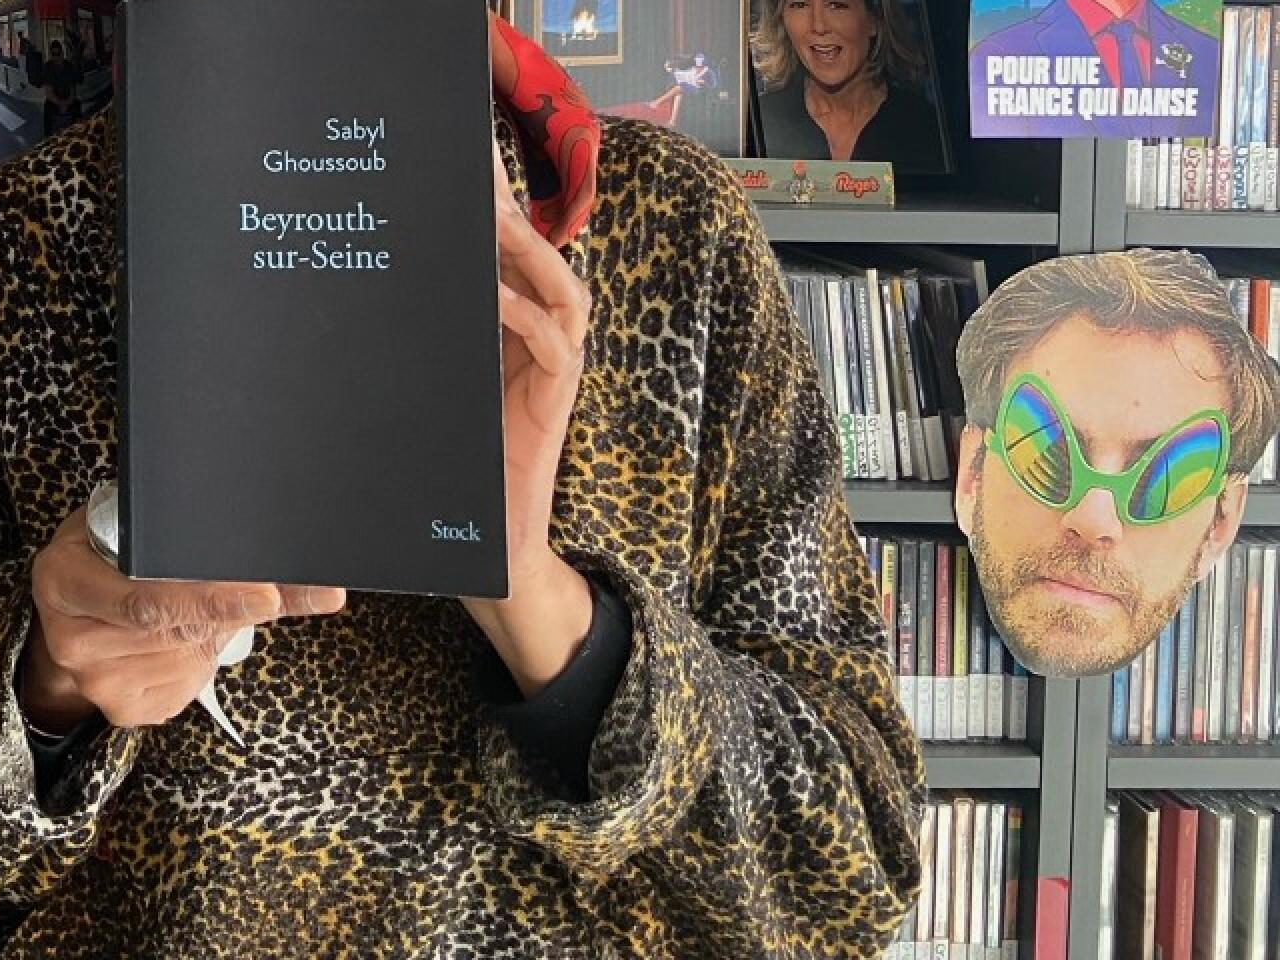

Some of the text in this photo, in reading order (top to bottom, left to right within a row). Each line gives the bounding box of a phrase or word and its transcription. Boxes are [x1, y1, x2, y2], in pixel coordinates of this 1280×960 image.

[987, 55, 1101, 85] POUR UNE
[987, 87, 1199, 120] FRANCE QUI DANSE
[325, 117, 386, 148] Sabyl
[263, 149, 387, 173] Ghoussoub
[239, 202, 388, 240] Beyrouth-
[252, 241, 390, 271] sur-Seine
[431, 519, 481, 542] Stock
